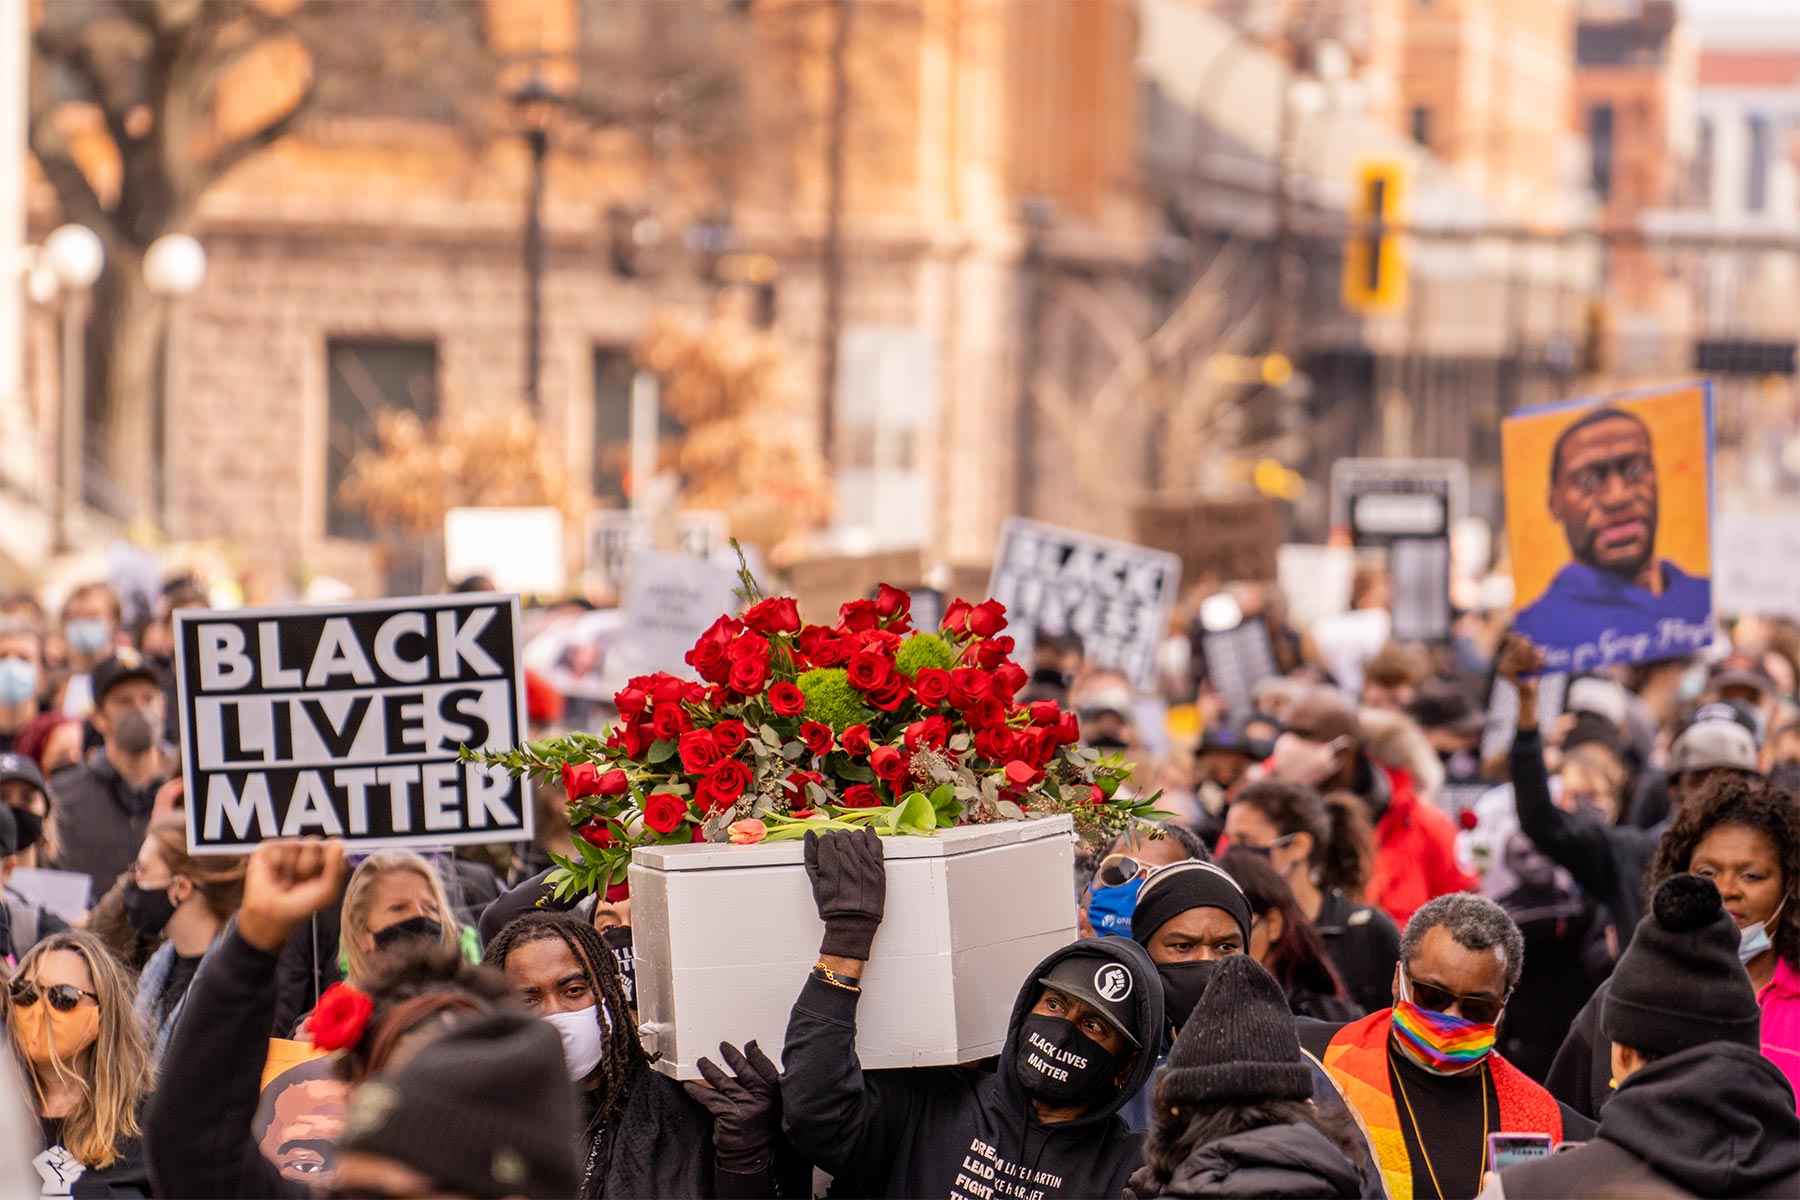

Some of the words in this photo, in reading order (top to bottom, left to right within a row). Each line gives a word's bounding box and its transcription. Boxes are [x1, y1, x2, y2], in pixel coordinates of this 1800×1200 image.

[198, 607, 503, 691] BLACK
[219, 688, 490, 763] LIVES
[203, 762, 520, 840] MATTER
[1027, 1053, 1069, 1082] MATTER
[1028, 1032, 1057, 1058] BLACK
[1055, 1049, 1088, 1070] LIVES
[955, 1173, 994, 1200] FIGHT
[962, 1155, 995, 1180] LEAD
